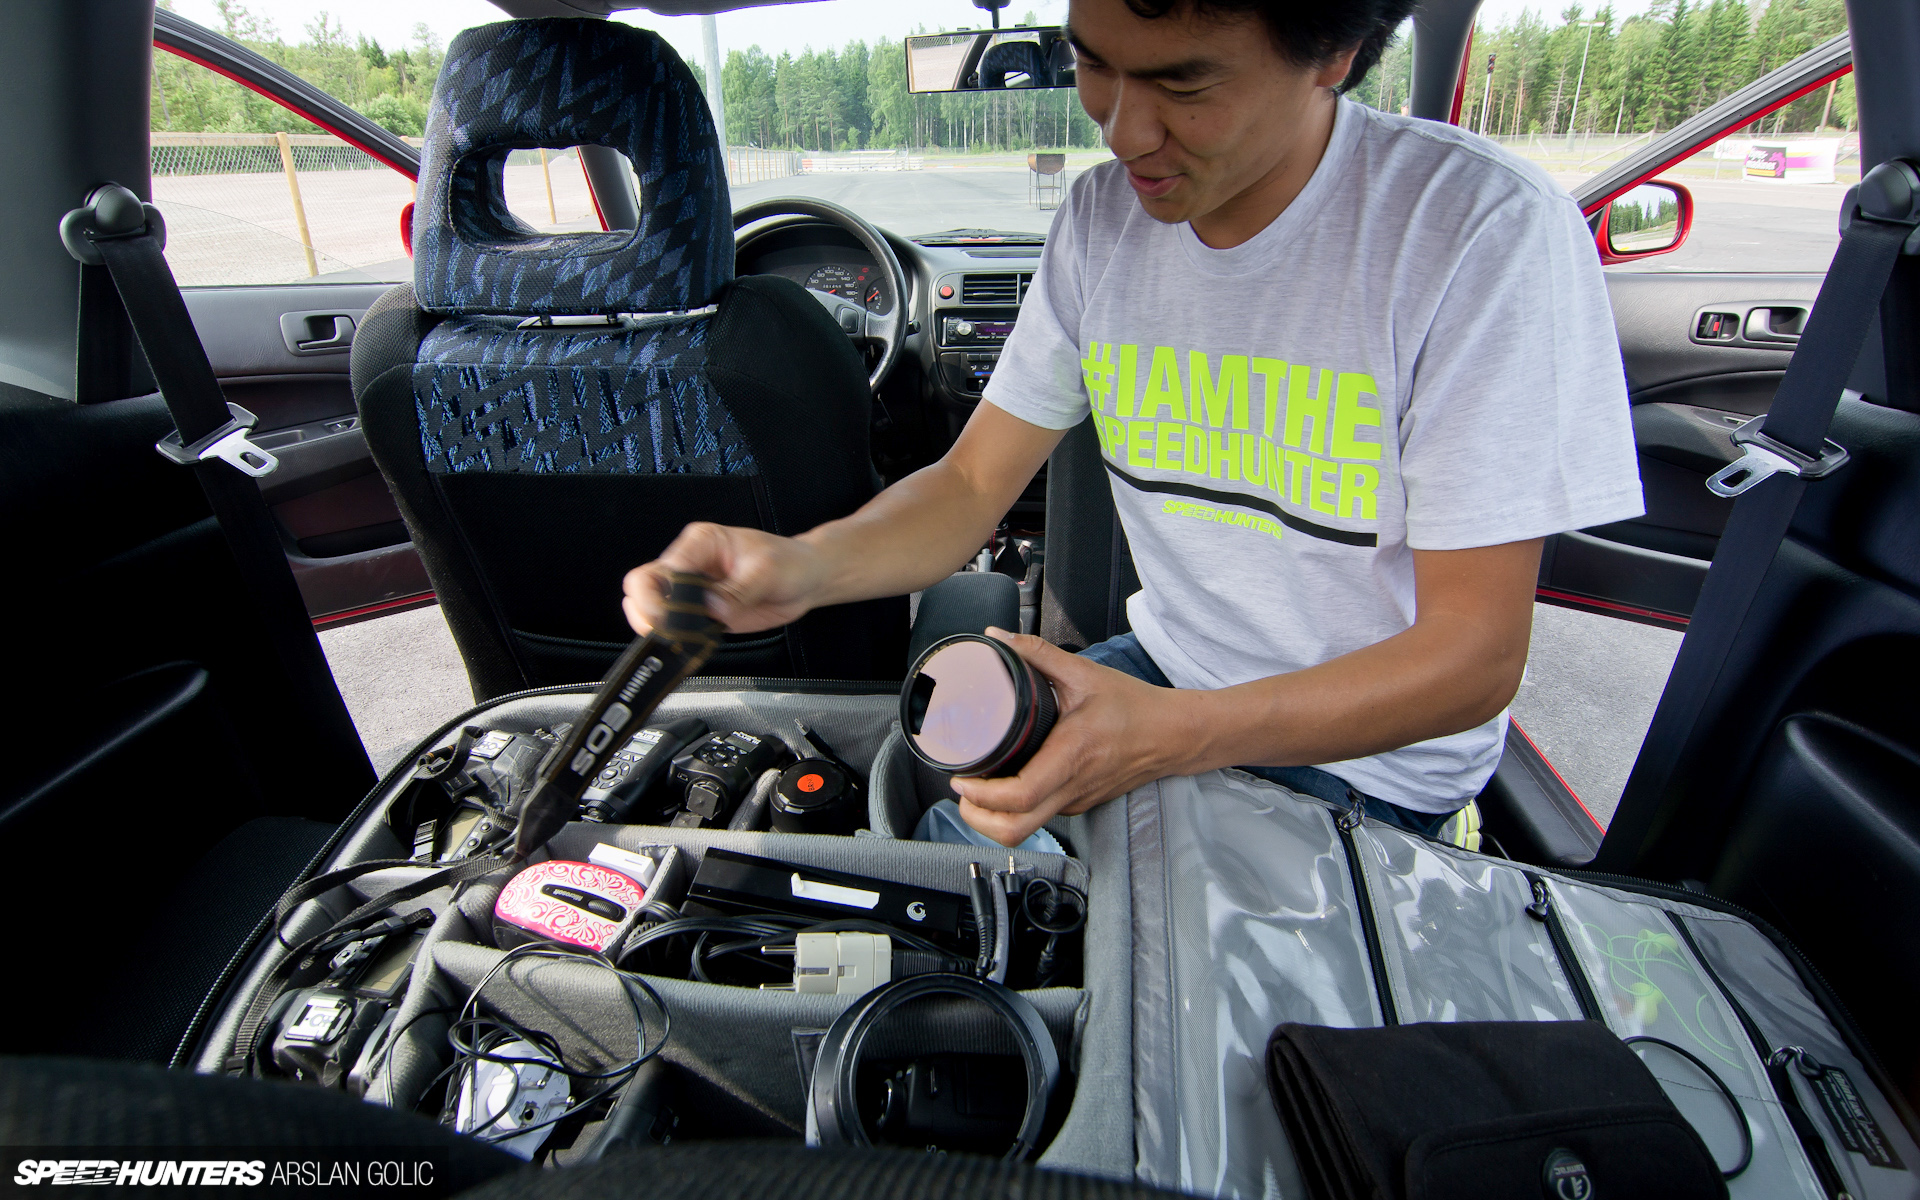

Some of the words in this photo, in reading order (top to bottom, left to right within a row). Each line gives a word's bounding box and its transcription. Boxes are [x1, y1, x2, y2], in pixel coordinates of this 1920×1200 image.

[1081, 341, 1382, 460] #IAMTHE
[1091, 409, 1379, 519] SPEEDHUNTER
[1162, 500, 1282, 539] SPEEDHUNTERS
[619, 656, 663, 703] Canon
[571, 702, 633, 777] EOS
